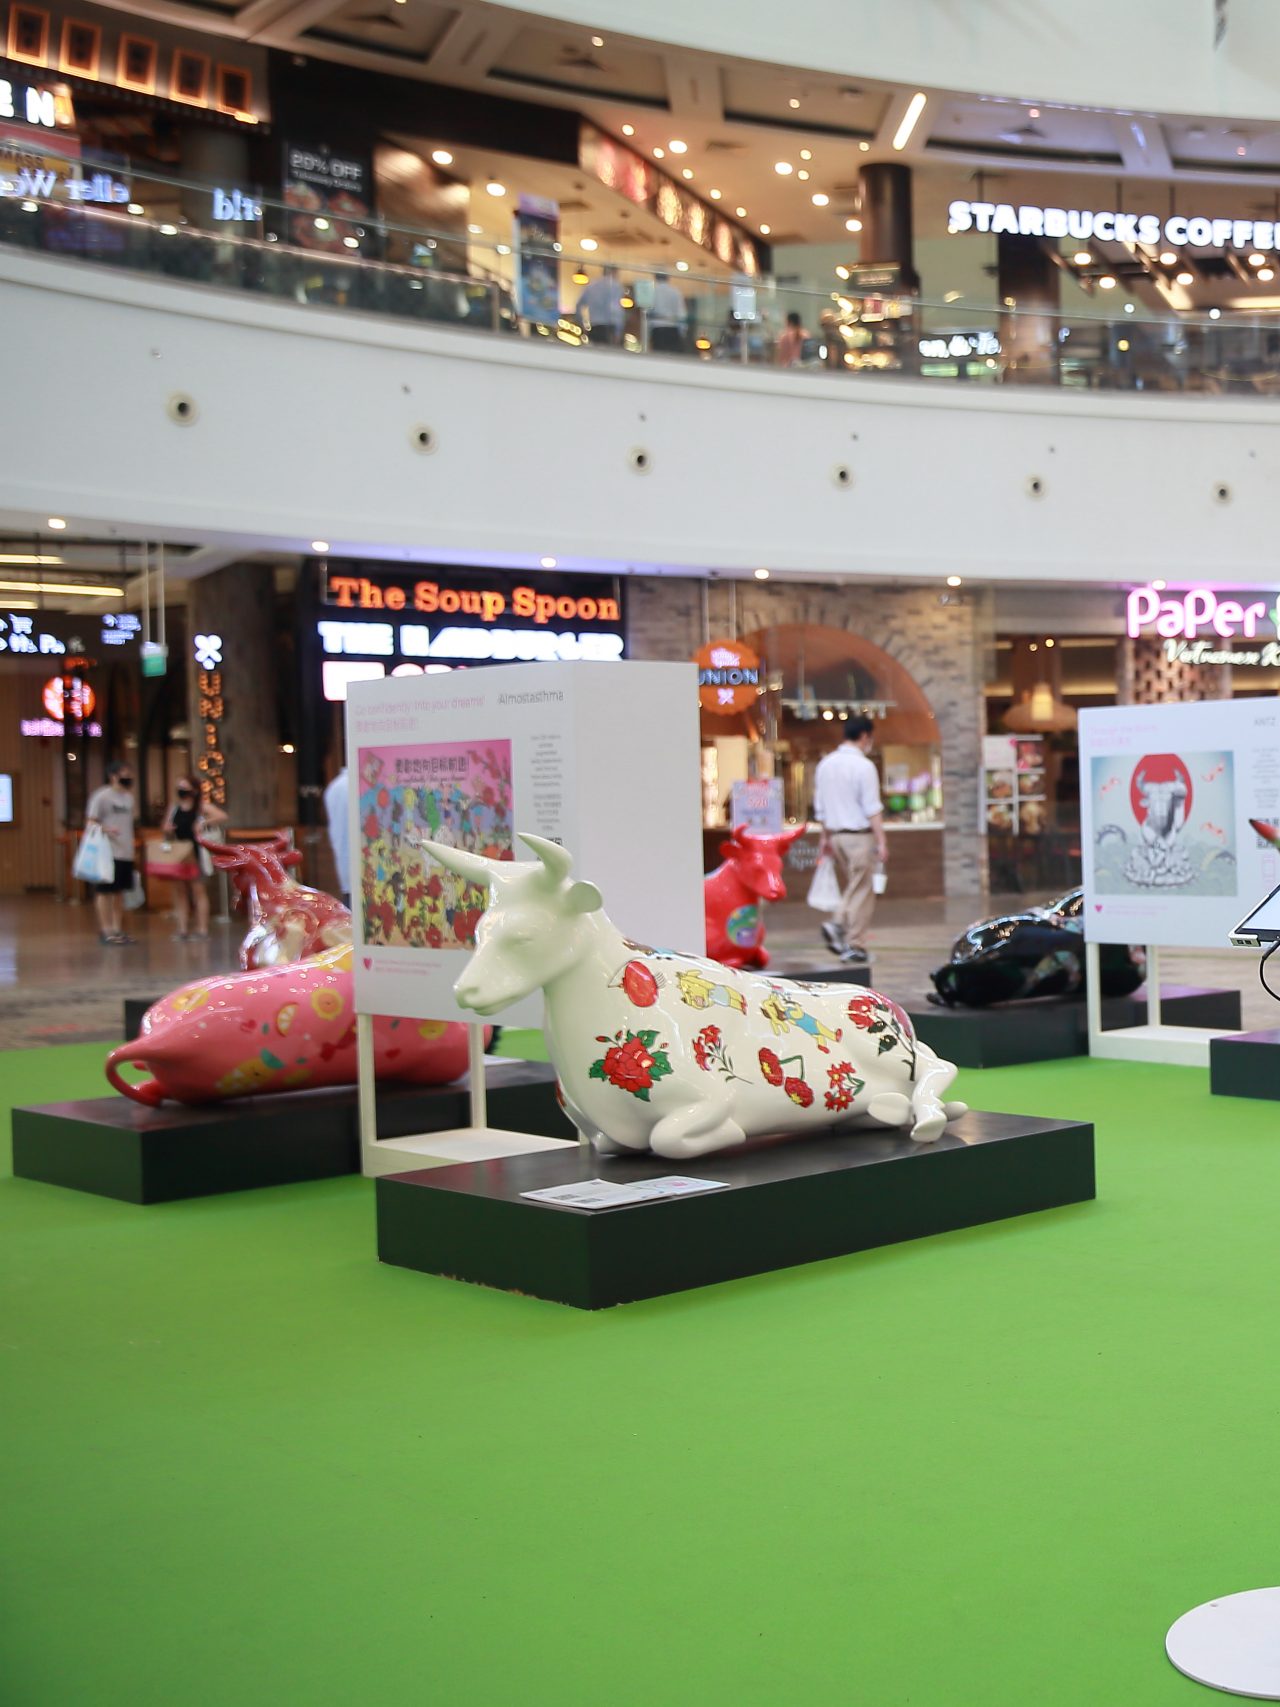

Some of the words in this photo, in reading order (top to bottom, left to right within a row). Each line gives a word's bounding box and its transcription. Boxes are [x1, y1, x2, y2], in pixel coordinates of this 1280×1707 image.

[948, 201, 1160, 245] STARBUCKS
[329, 576, 406, 610] The
[414, 581, 505, 622] Soup
[512, 586, 620, 624] Spoon
